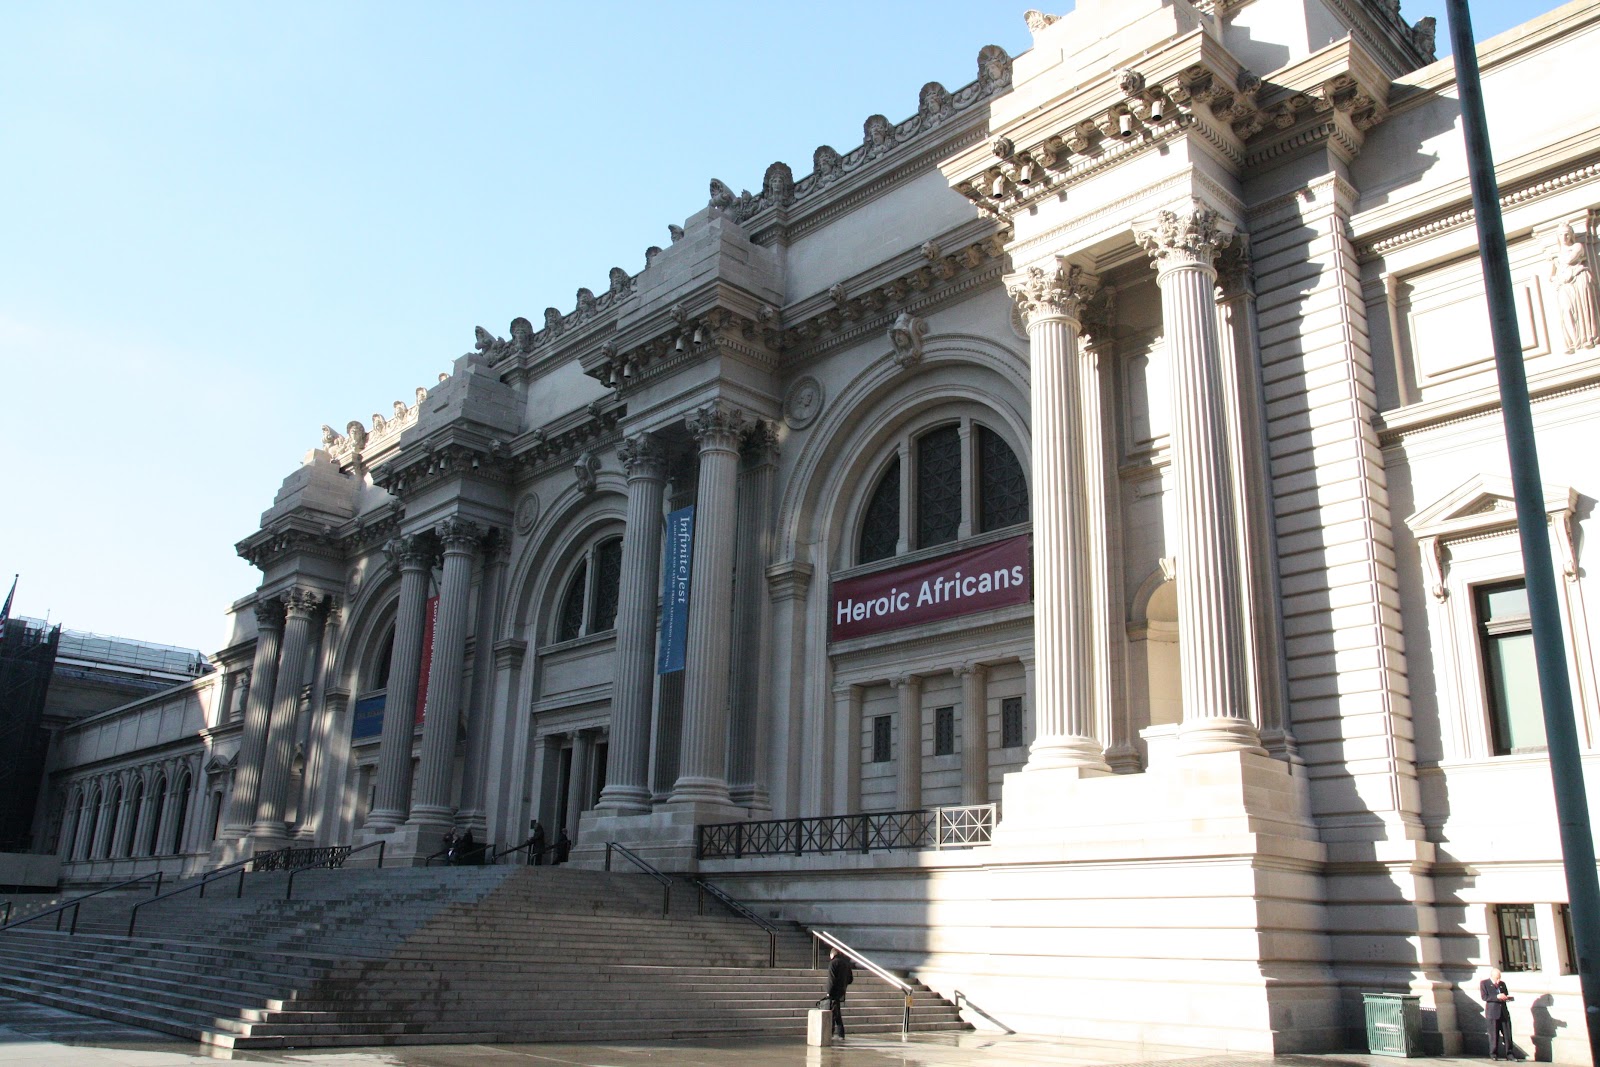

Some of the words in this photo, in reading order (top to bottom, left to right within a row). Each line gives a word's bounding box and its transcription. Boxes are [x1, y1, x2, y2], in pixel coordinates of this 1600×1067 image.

[679, 517, 690, 574] Infinite
[677, 575, 688, 603] Jest
[836, 588, 910, 625] Heroic
[916, 565, 1024, 607] Africans
